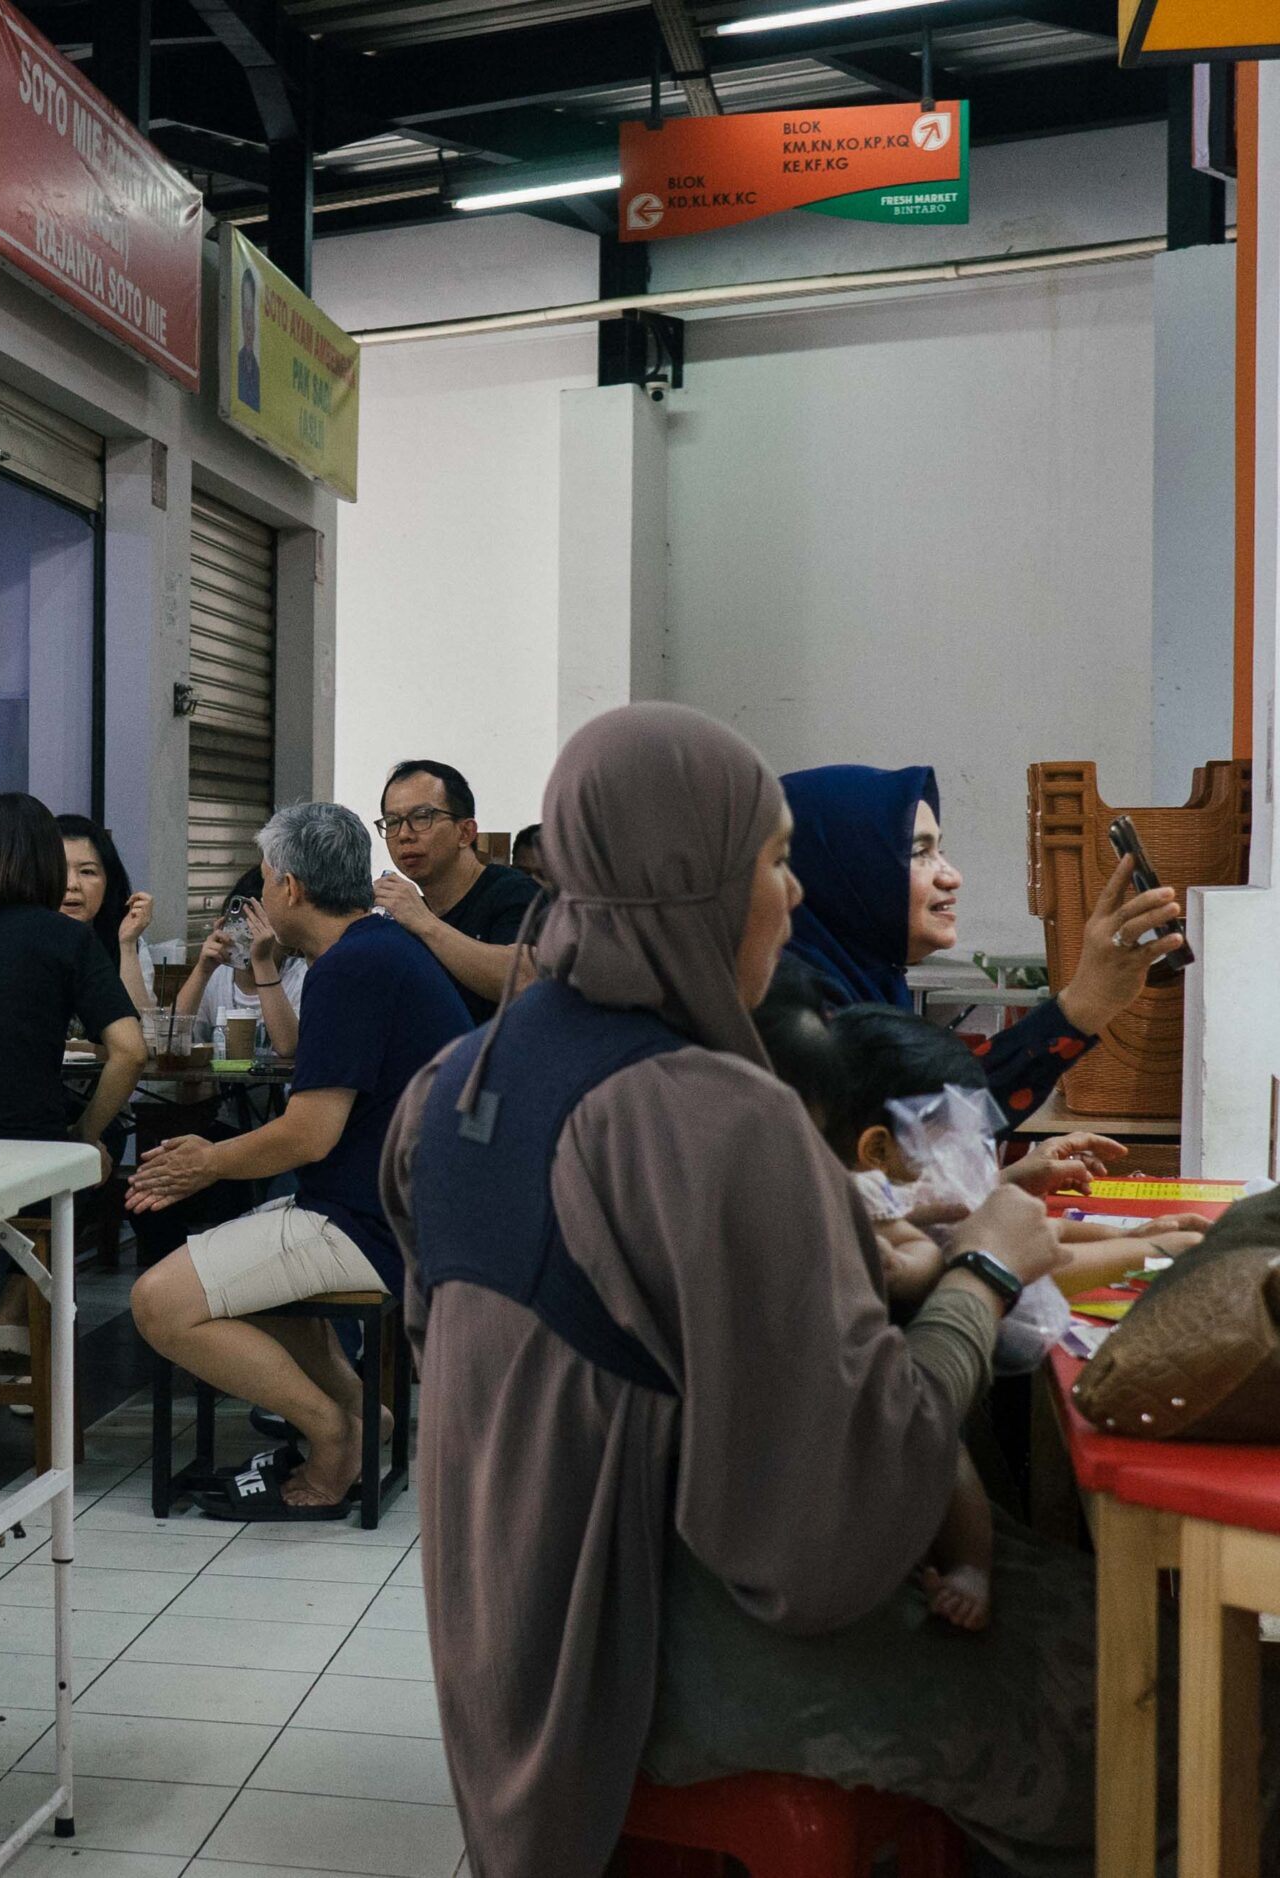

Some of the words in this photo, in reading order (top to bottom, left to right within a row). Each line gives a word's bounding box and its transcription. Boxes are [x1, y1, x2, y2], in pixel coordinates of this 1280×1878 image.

[19, 51, 69, 137] SOTO
[73, 101, 104, 170] MIE
[783, 121, 820, 135] BLOK
[668, 176, 705, 190] BLOK
[881, 194, 913, 206] FRESH
[914, 192, 958, 204] MARKET
[893, 203, 947, 215] BINTARO
[35, 207, 105, 299] RAJANYA
[108, 268, 143, 328] SOTO
[146, 294, 167, 346] MIE
